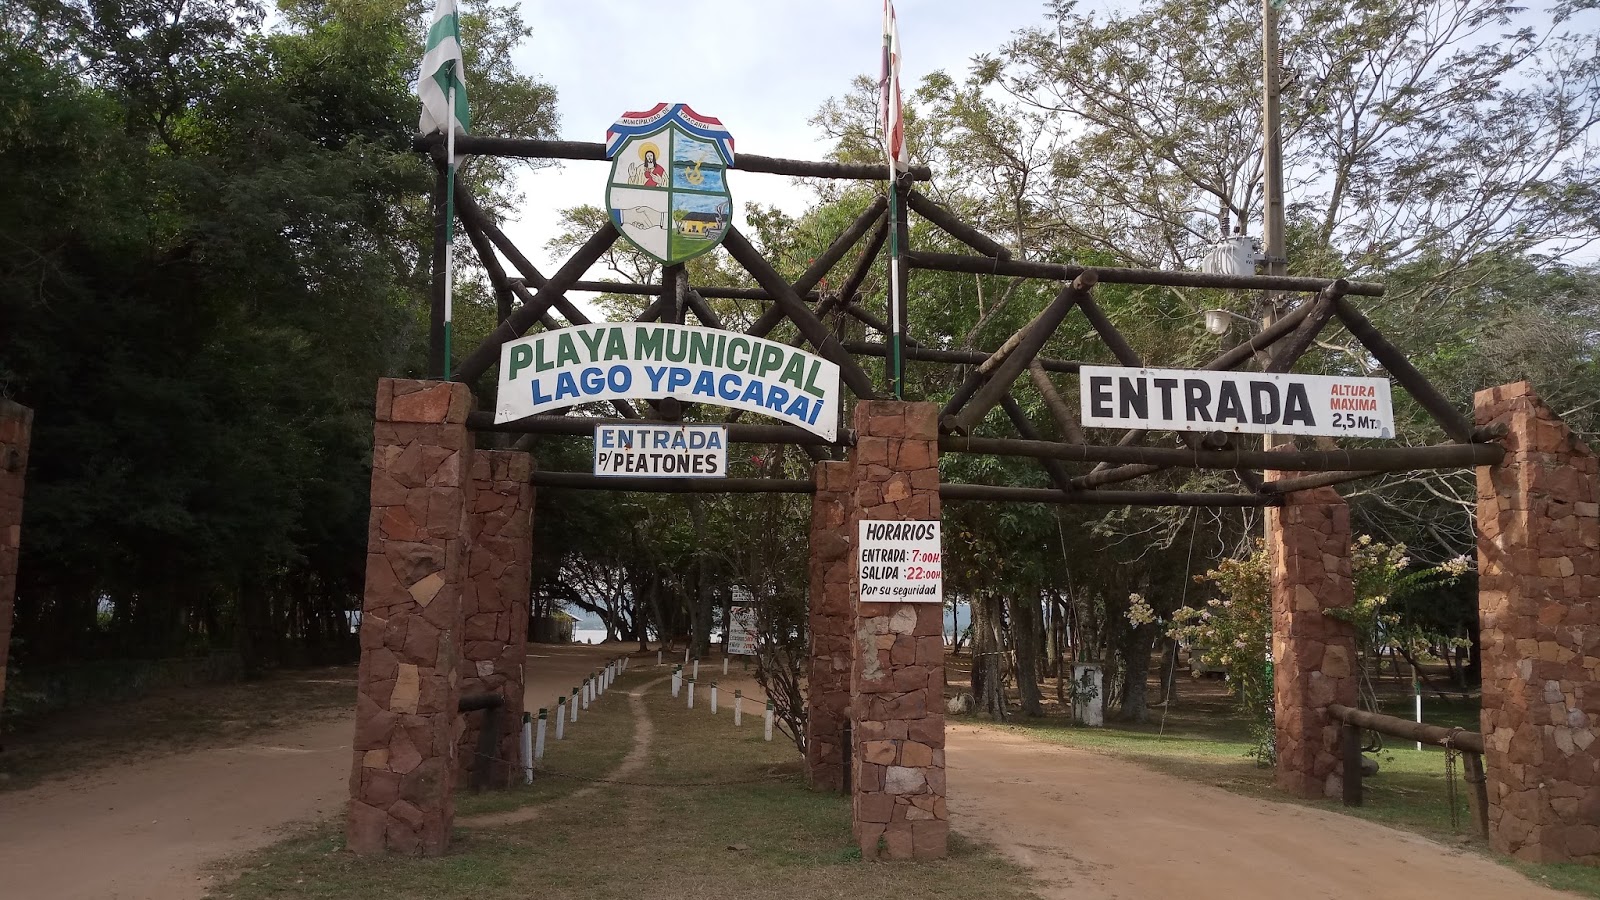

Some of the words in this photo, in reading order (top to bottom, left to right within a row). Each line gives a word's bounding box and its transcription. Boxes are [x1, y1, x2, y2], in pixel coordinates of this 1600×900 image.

[622, 114, 660, 125] MUNICIPALIDAD
[662, 107, 669, 115] DE
[509, 327, 628, 381] PLAYA
[634, 327, 825, 397] MUNICIPAL
[531, 365, 632, 406] LAGO
[644, 366, 825, 426] YPACARAÍ
[1331, 384, 1375, 397] ALTURA
[1090, 376, 1316, 427] ENTRADA
[1330, 398, 1377, 411] MAXIMA
[1332, 412, 1356, 430] 2,5
[602, 430, 722, 449] ENTRADA
[866, 523, 935, 541] HORARIOS
[861, 566, 899, 580] SALIDA
[860, 583, 878, 595] Por
[879, 585, 891, 595] su
[893, 584, 937, 597] seguridad
